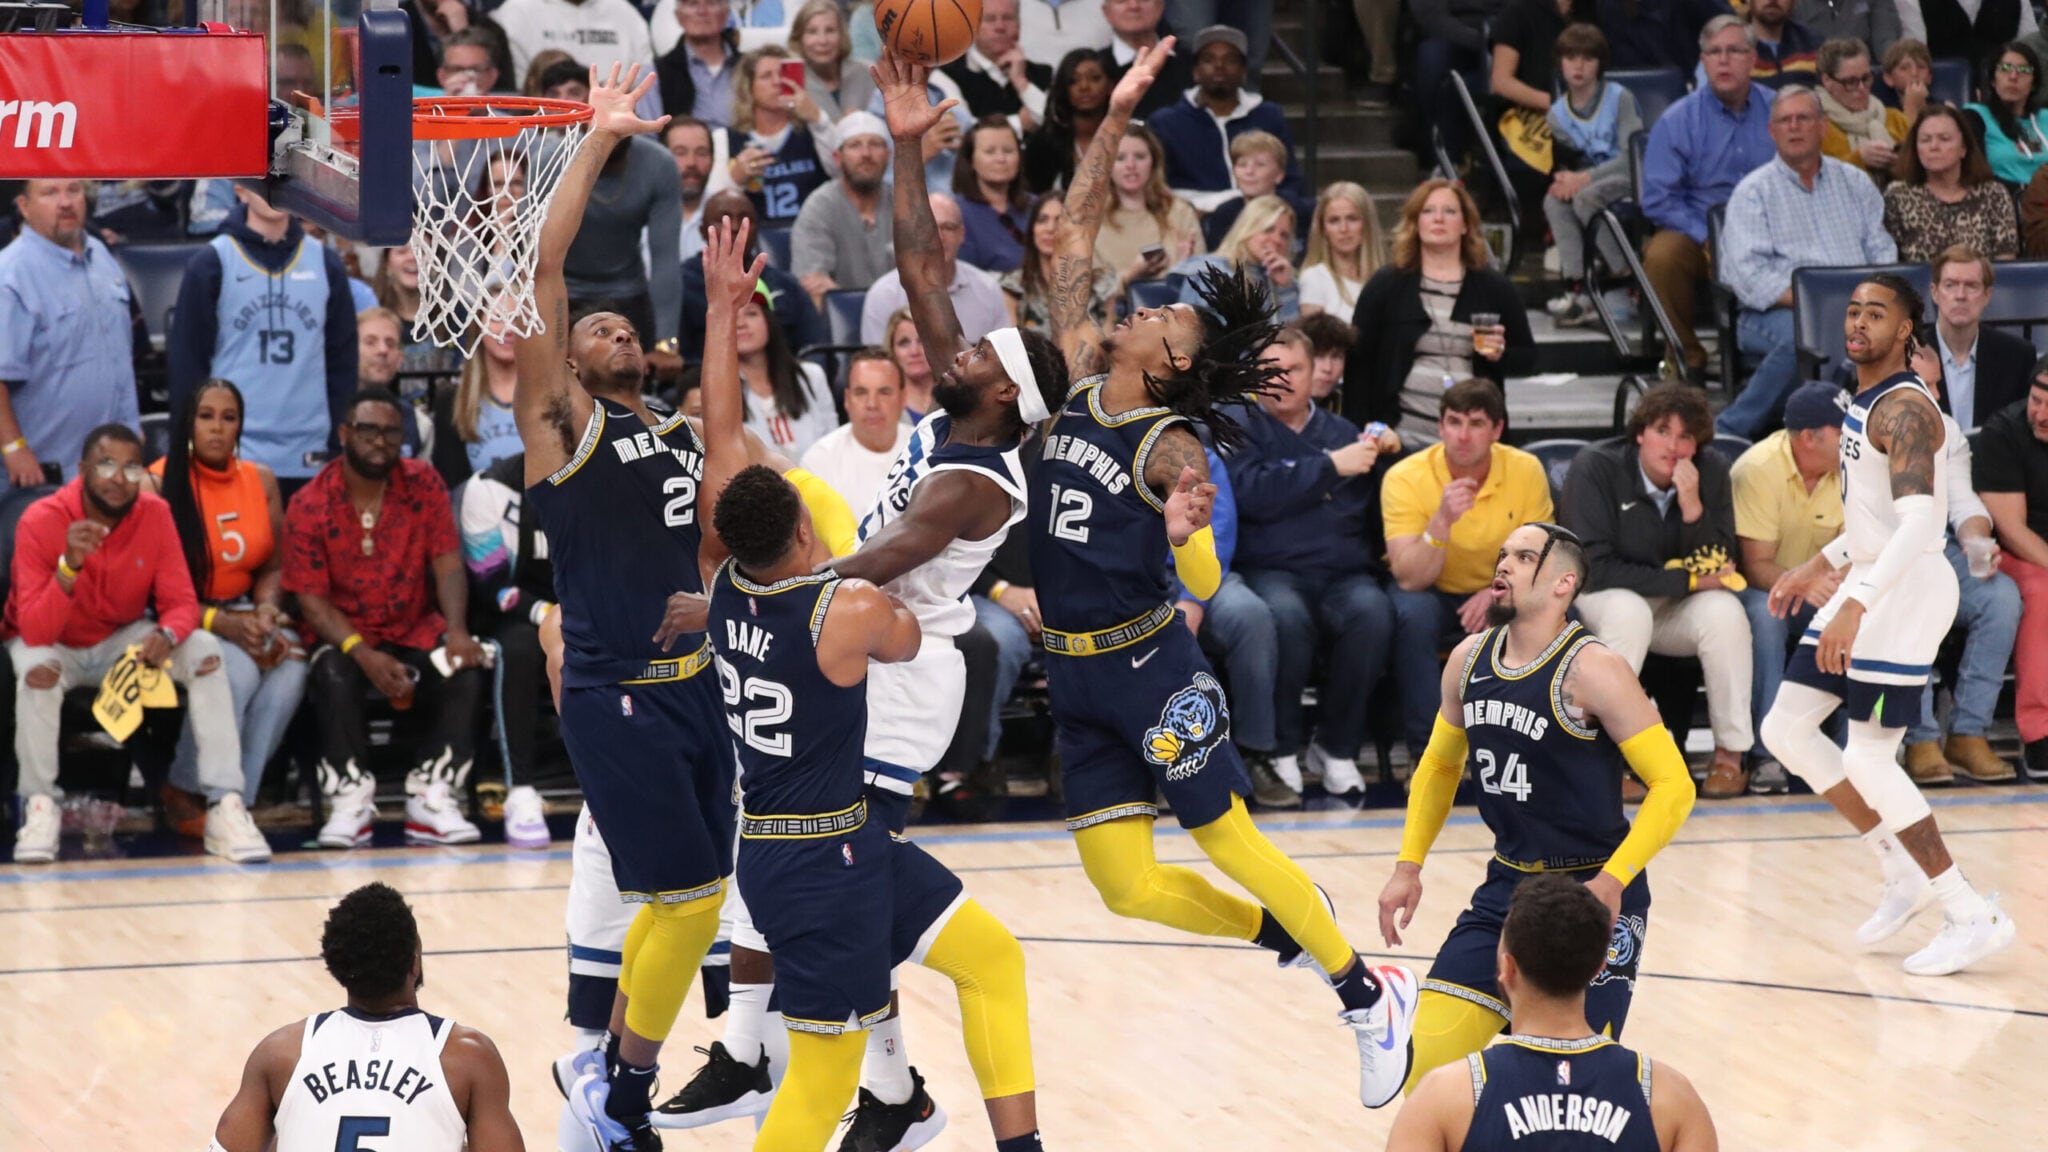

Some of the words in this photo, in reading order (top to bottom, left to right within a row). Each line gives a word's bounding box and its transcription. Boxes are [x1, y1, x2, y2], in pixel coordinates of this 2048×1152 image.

[764, 182, 799, 218] 12
[258, 330, 295, 364] 13
[1042, 434, 1131, 495] MEMPHIS
[662, 476, 696, 527] 2
[1048, 483, 1093, 543] 12
[215, 511, 246, 563] 5
[726, 619, 774, 663] BANE
[718, 654, 794, 758] 22
[1463, 699, 1549, 741] MEMPHIS
[1476, 748, 1532, 802] 24
[303, 1059, 434, 1105] BEASLEY
[1503, 1093, 1632, 1144] ANDERSON
